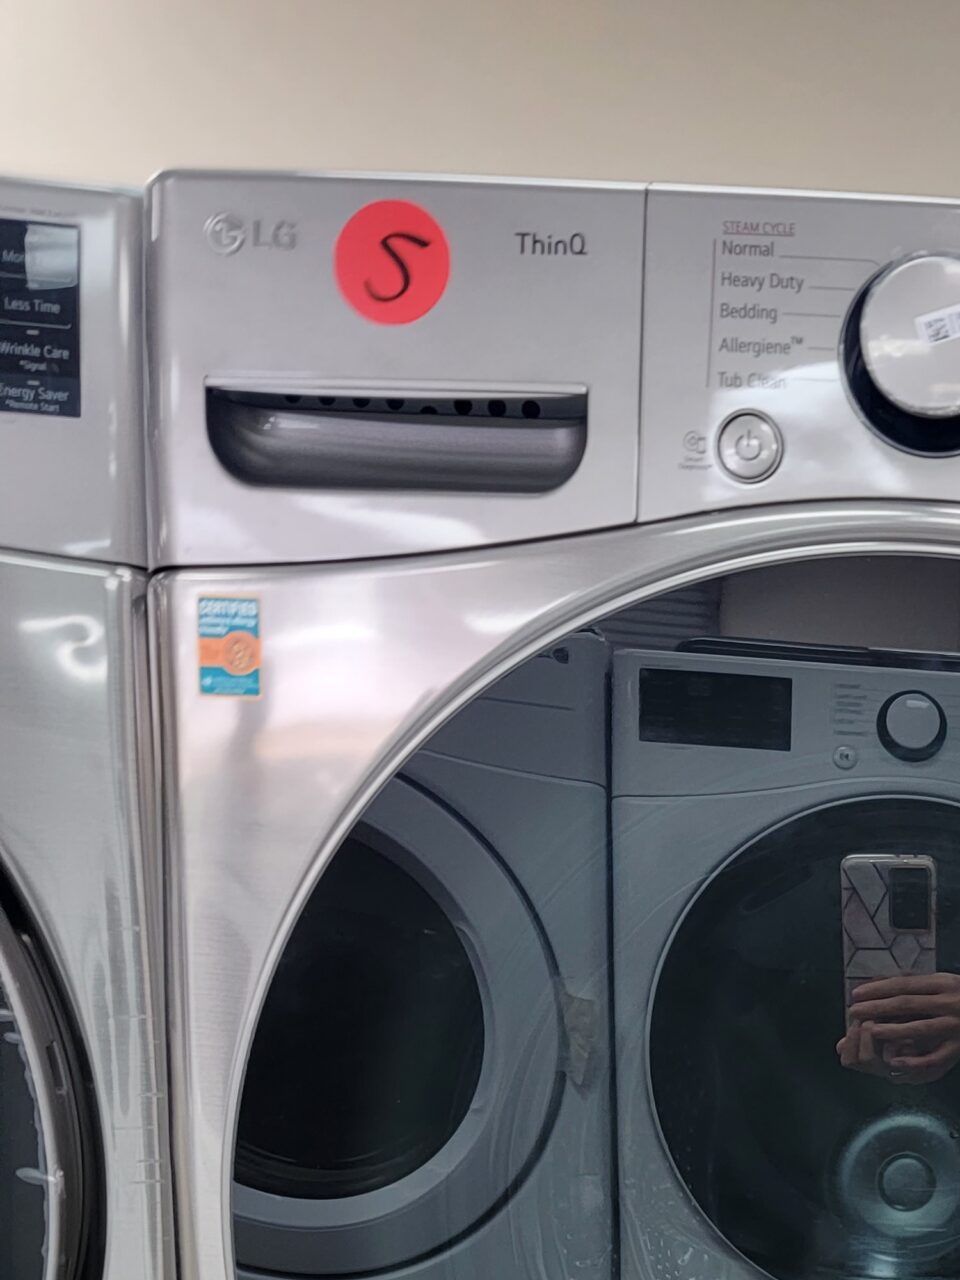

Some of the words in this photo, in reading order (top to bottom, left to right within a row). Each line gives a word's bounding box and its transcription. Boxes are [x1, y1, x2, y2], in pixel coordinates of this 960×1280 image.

[252, 220, 297, 250] LG
[722, 220, 760, 235] STEAM
[762, 221, 796, 237] CYCLE
[514, 232, 588, 256] ThinQ
[721, 240, 775, 257] Normal
[1, 249, 25, 264] Mor
[720, 271, 765, 293] Heavy
[769, 272, 804, 294] Duty
[3, 297, 30, 312] Less
[33, 298, 61, 315] Time
[719, 302, 778, 325] Bedding
[0, 341, 41, 357] Wrinkle
[43, 344, 70, 361] Care
[717, 370, 743, 389] Tub
[37, 386, 70, 402] Saver
